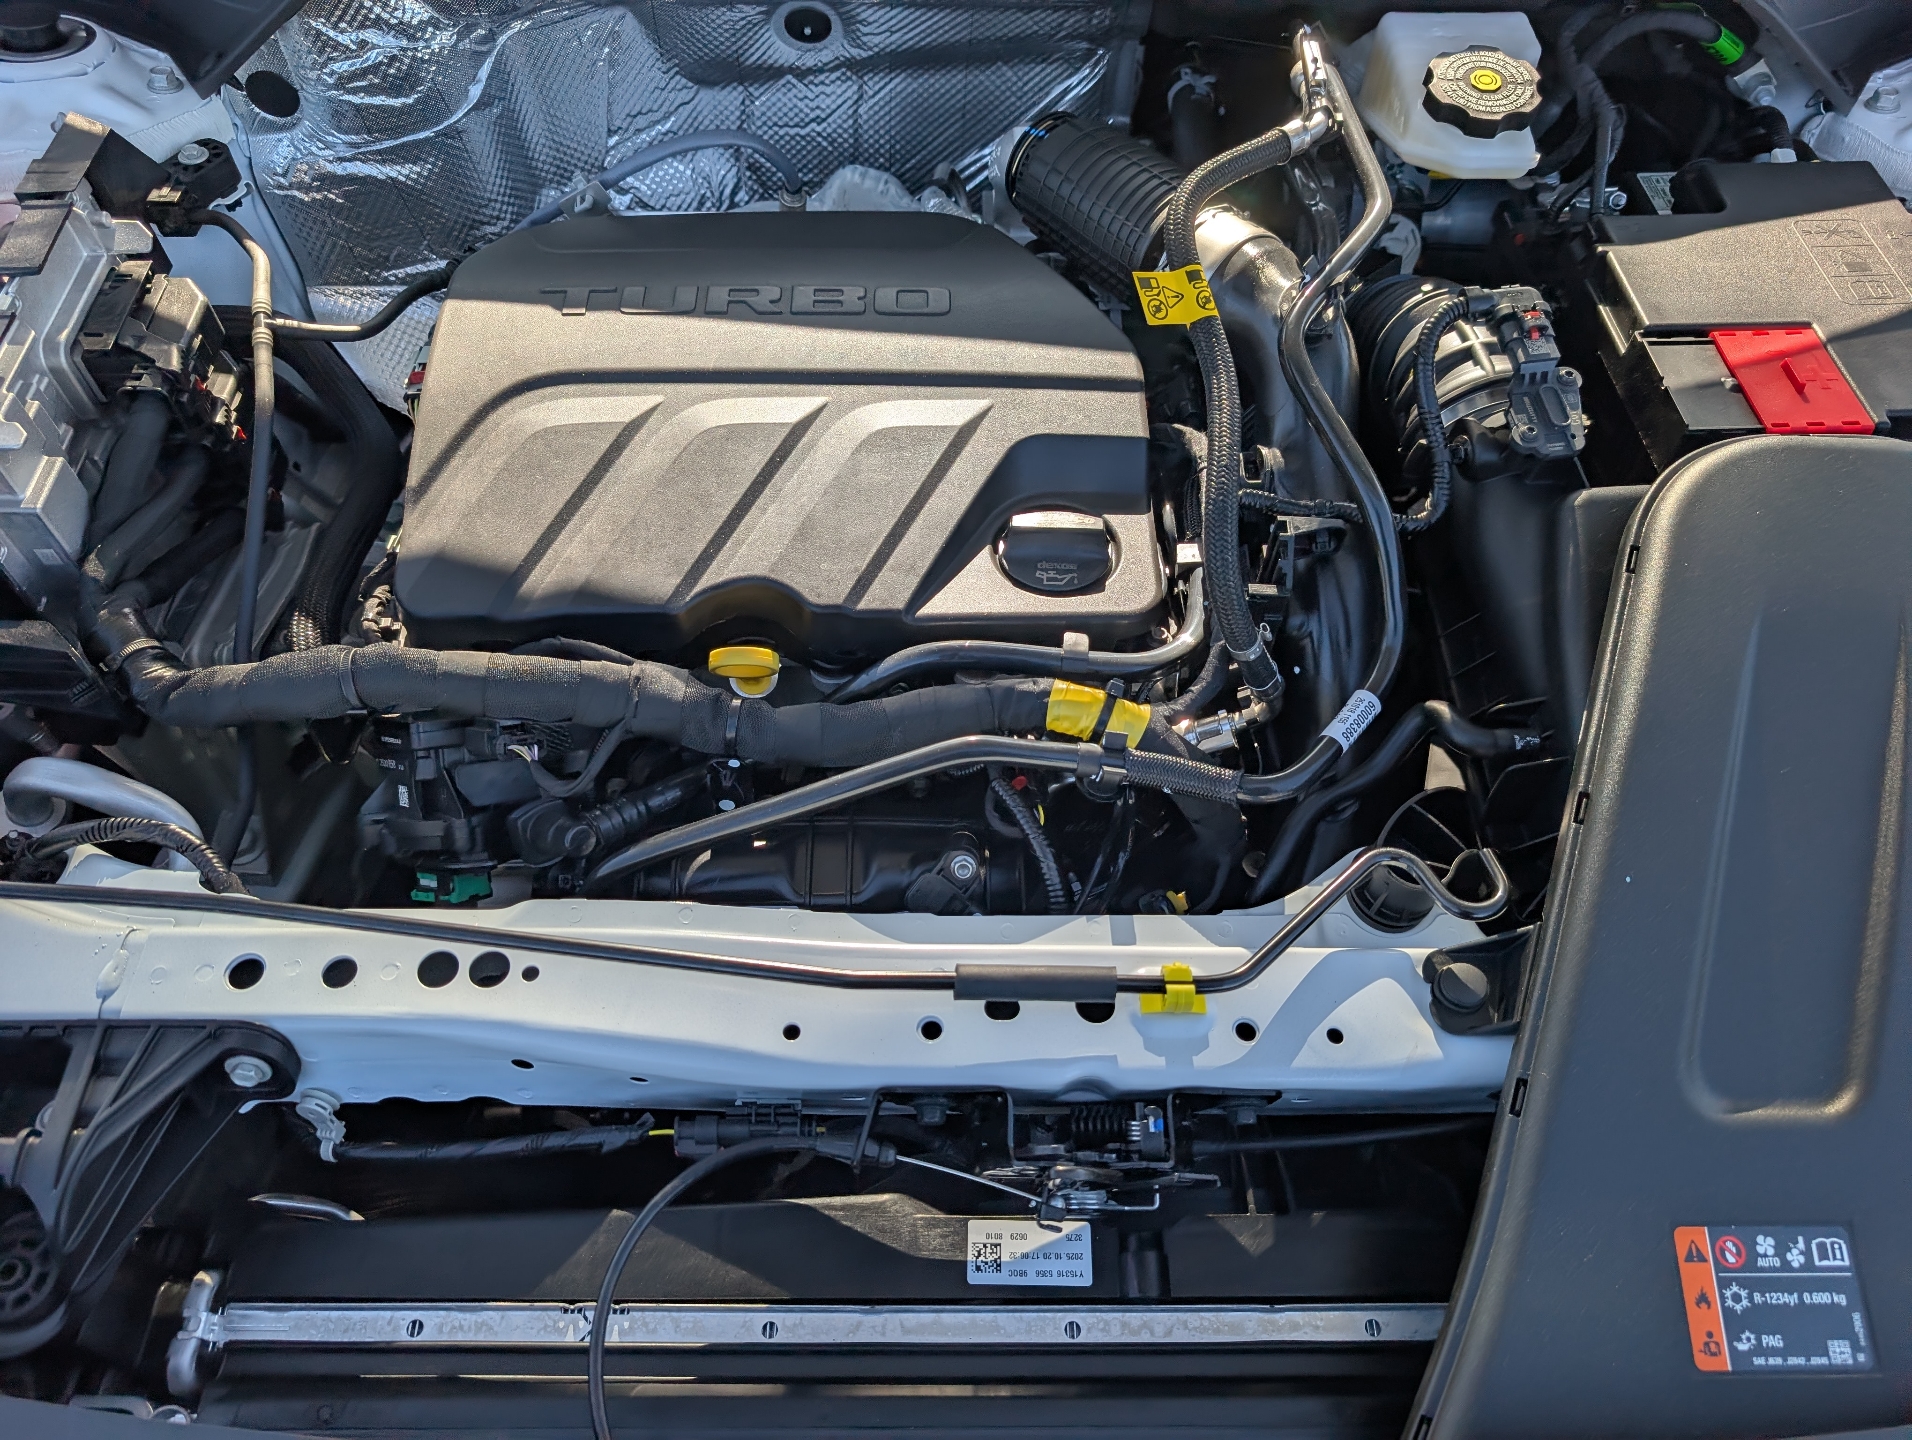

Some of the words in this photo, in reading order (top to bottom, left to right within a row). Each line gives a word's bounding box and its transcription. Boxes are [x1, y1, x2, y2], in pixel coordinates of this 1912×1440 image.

[1482, 92, 1504, 101] CLEAN
[1466, 102, 1485, 112] FROM
[1491, 104, 1516, 113] SEALED
[539, 284, 952, 317] TURBO
[1341, 700, 1376, 742] 60008388
[1042, 1252, 1084, 1260] 2025.10.20
[1757, 1257, 1781, 1267] AUTO
[1753, 1293, 1799, 1307] R-1234yf
[1803, 1293, 1832, 1304] 0.600
[1833, 1293, 1846, 1307] kg
[1762, 1335, 1783, 1348] PAG
